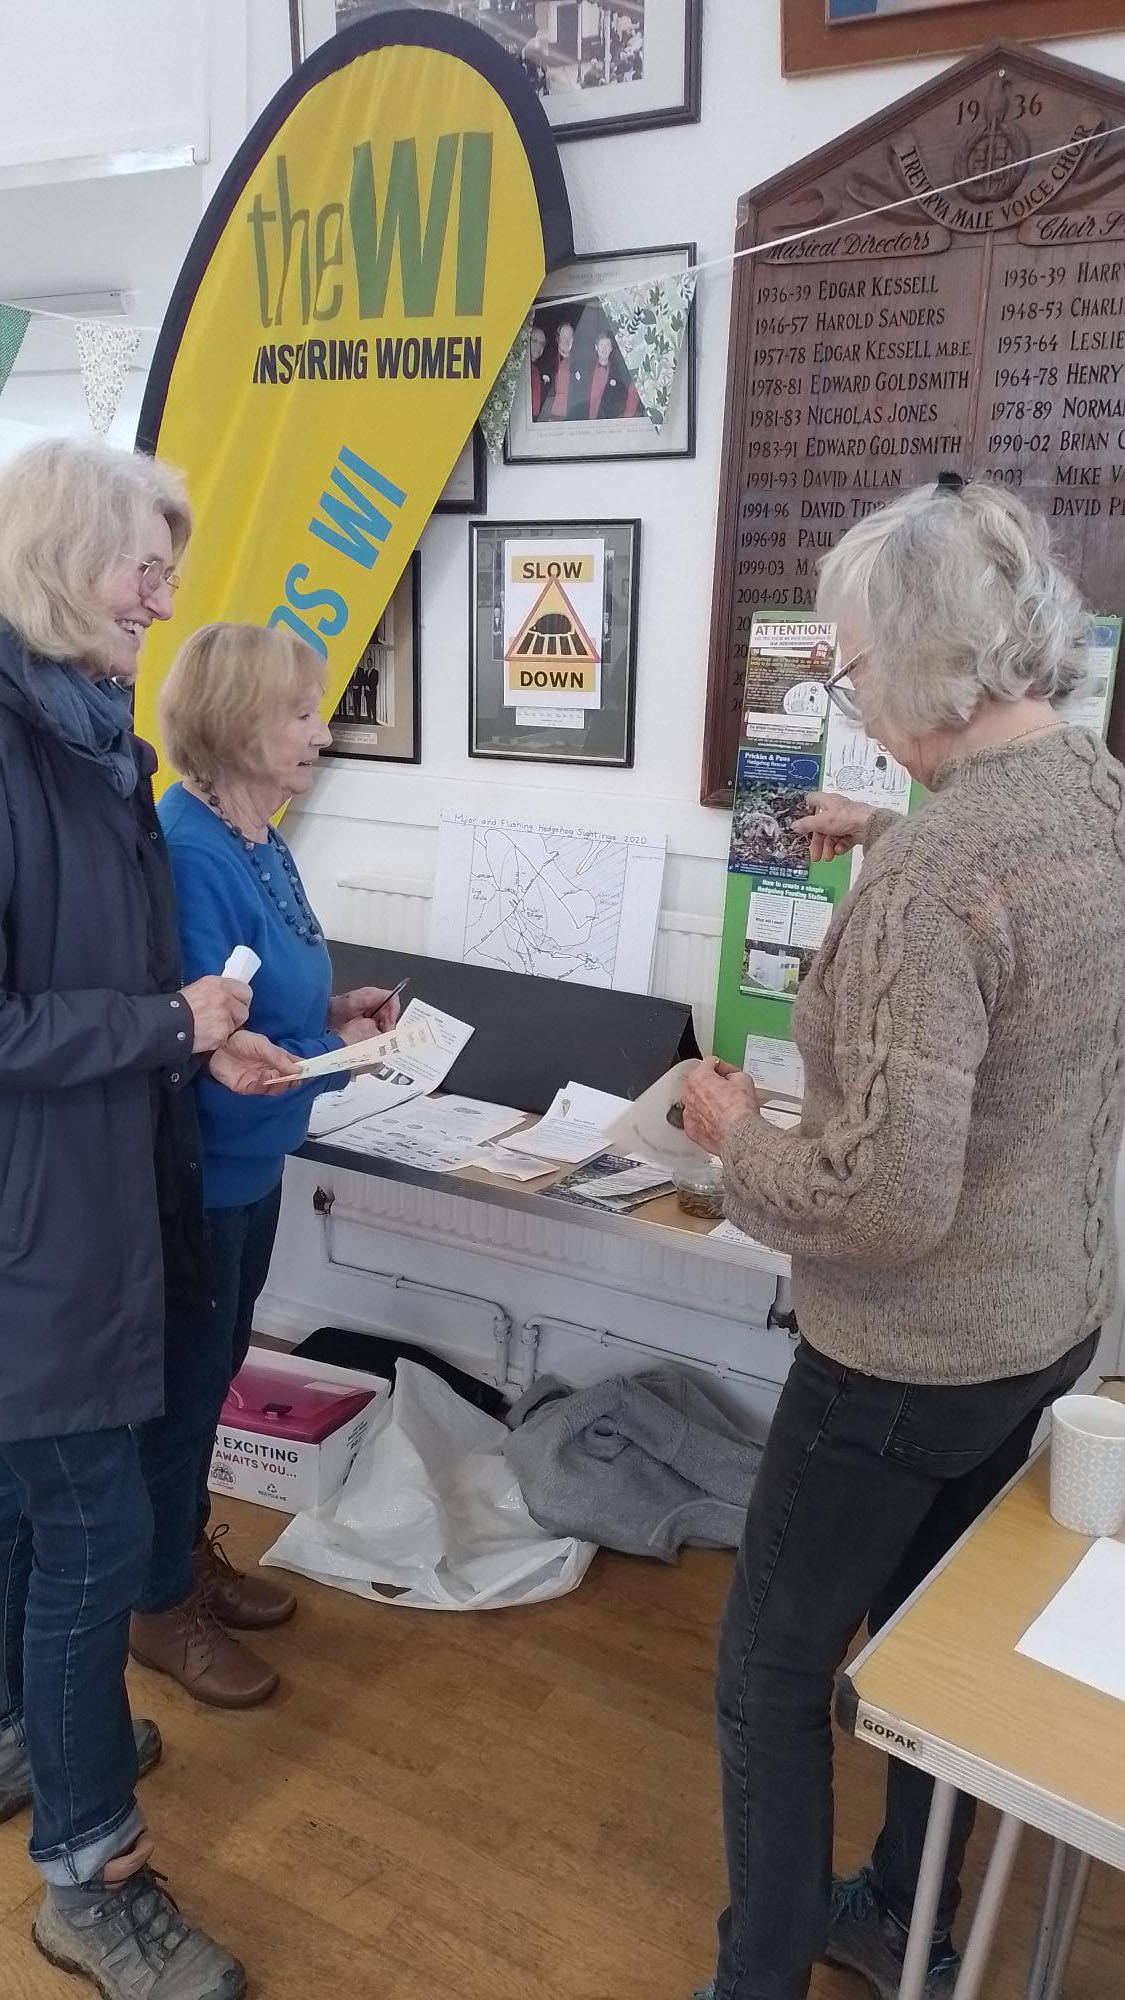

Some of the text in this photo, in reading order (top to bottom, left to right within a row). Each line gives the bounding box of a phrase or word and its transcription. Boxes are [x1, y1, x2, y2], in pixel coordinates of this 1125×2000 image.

[950, 208, 995, 229] MALE
[1001, 181, 1054, 221] VOICE
[1051, 124, 1094, 181] CHOIR
[1037, 216, 1096, 240] Choir
[766, 231, 930, 259] Musical Directors
[757, 274, 939, 304] 1936-39 EDGAR KESSELL
[1004, 266, 1066, 288] 1936-39
[755, 307, 946, 335] 1946-57 HAROLD SANDERS
[1001, 297, 1125, 321] 1948-53 CHARLI
[754, 347, 807, 366] 1957-78
[813, 342, 861, 363] EDGAR
[865, 339, 931, 360] KESSELL
[997, 334, 1059, 354] 1953-64
[376, 336, 482, 379] WOMEN
[751, 371, 969, 396] 1978-81 EDWARD GOLDSMITH
[995, 367, 1058, 388] 1964-78
[750, 403, 938, 427] 1981-83 NICHOLAS JONES
[991, 396, 1125, 420] 1978-89 NORMA
[749, 435, 962, 459] 1983-91 EDWARD GOLDSMITH
[988, 434, 1051, 453] 1990-02
[1060, 430, 1109, 451] BRIAN
[746, 469, 902, 489] 1991-93 DAVID ALLAN
[1056, 465, 1102, 486] MIKE
[308, 444, 408, 570] WI
[801, 500, 845, 518] DAVID
[1051, 497, 1101, 517] DAVID
[798, 529, 836, 548] PAUL
[522, 561, 583, 579] SLOW
[755, 624, 832, 636] ATTENTION!
[520, 670, 584, 689] DOWN
[454, 814, 477, 826] Mylor
[500, 819, 533, 833] Flushing
[538, 825, 574, 837] Hedgehog
[577, 828, 617, 841] Sightings
[624, 836, 647, 845] 2020
[223, 1437, 299, 1463] EXCITING
[215, 1450, 297, 1478] AWAITS YOU...
[862, 1718, 917, 1752] GOPAK
